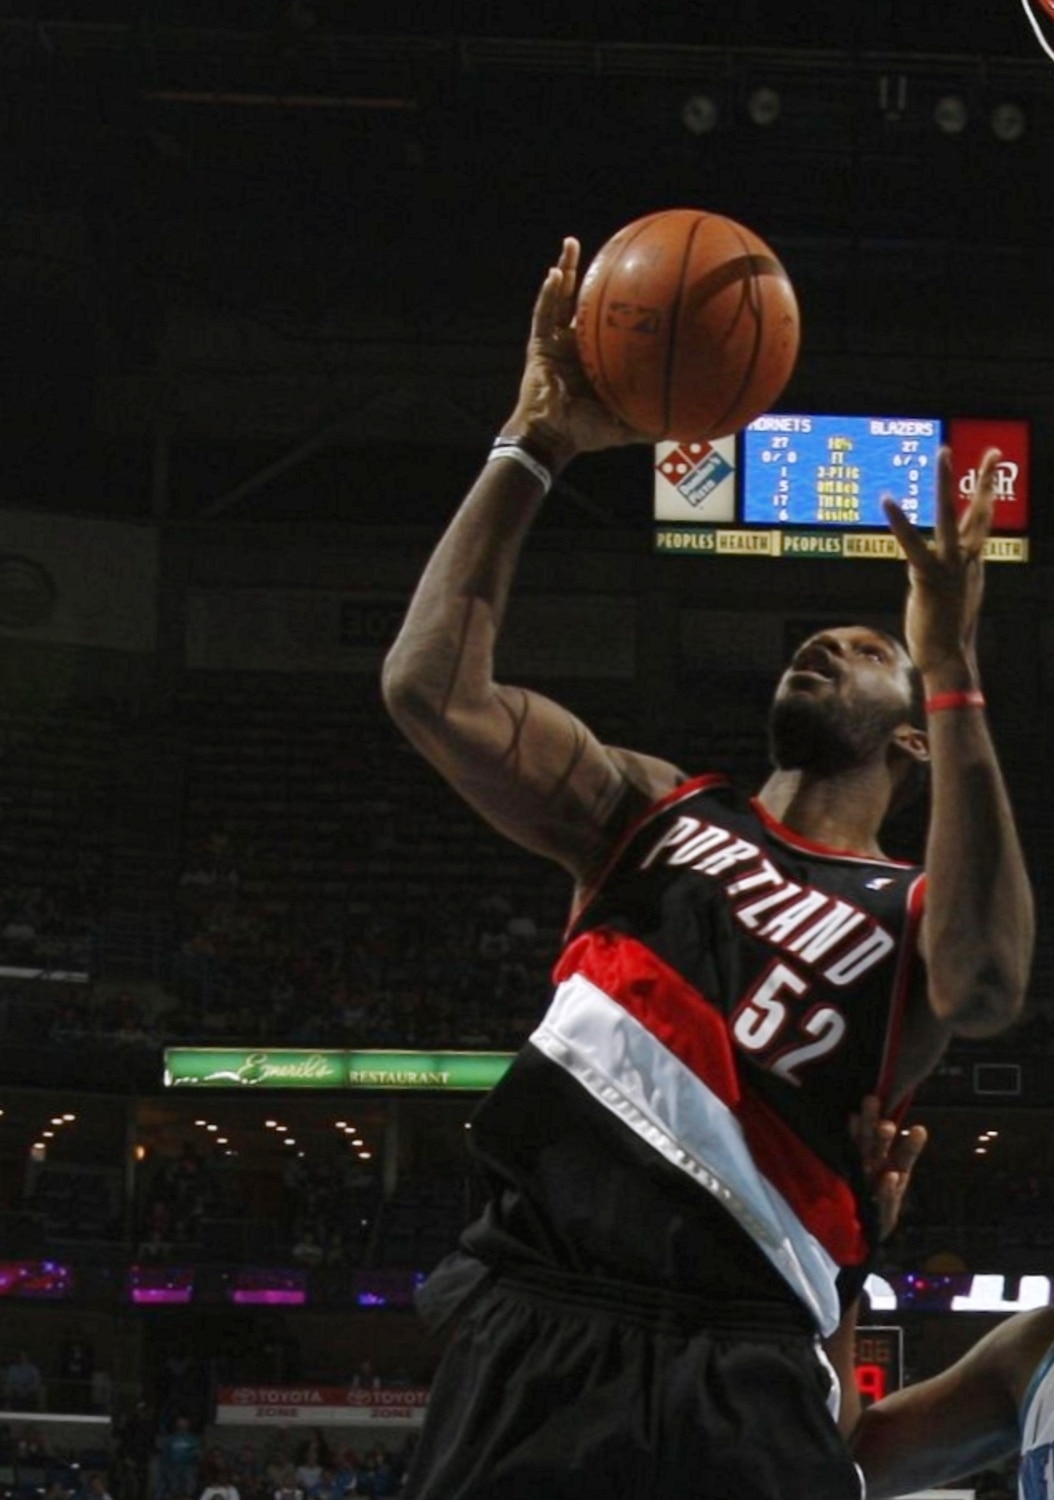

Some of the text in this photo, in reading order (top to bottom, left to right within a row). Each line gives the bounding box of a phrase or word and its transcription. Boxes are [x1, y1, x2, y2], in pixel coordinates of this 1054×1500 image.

[870, 421, 933, 436] BLAZERS
[772, 437, 789, 449] 27
[902, 440, 919, 453] 27
[773, 494, 789, 506] 17
[656, 533, 769, 549] PEOPLES HEALTH
[784, 536, 895, 554] PEOPLES HEALTH
[640, 815, 895, 986] PORTLAND
[731, 960, 847, 1088] 52
[350, 1070, 449, 1086] RESTAURANT
[258, 1389, 322, 1404] TOYOTA
[256, 1407, 299, 1418] ZONE
[371, 1408, 414, 1419] ZONE
